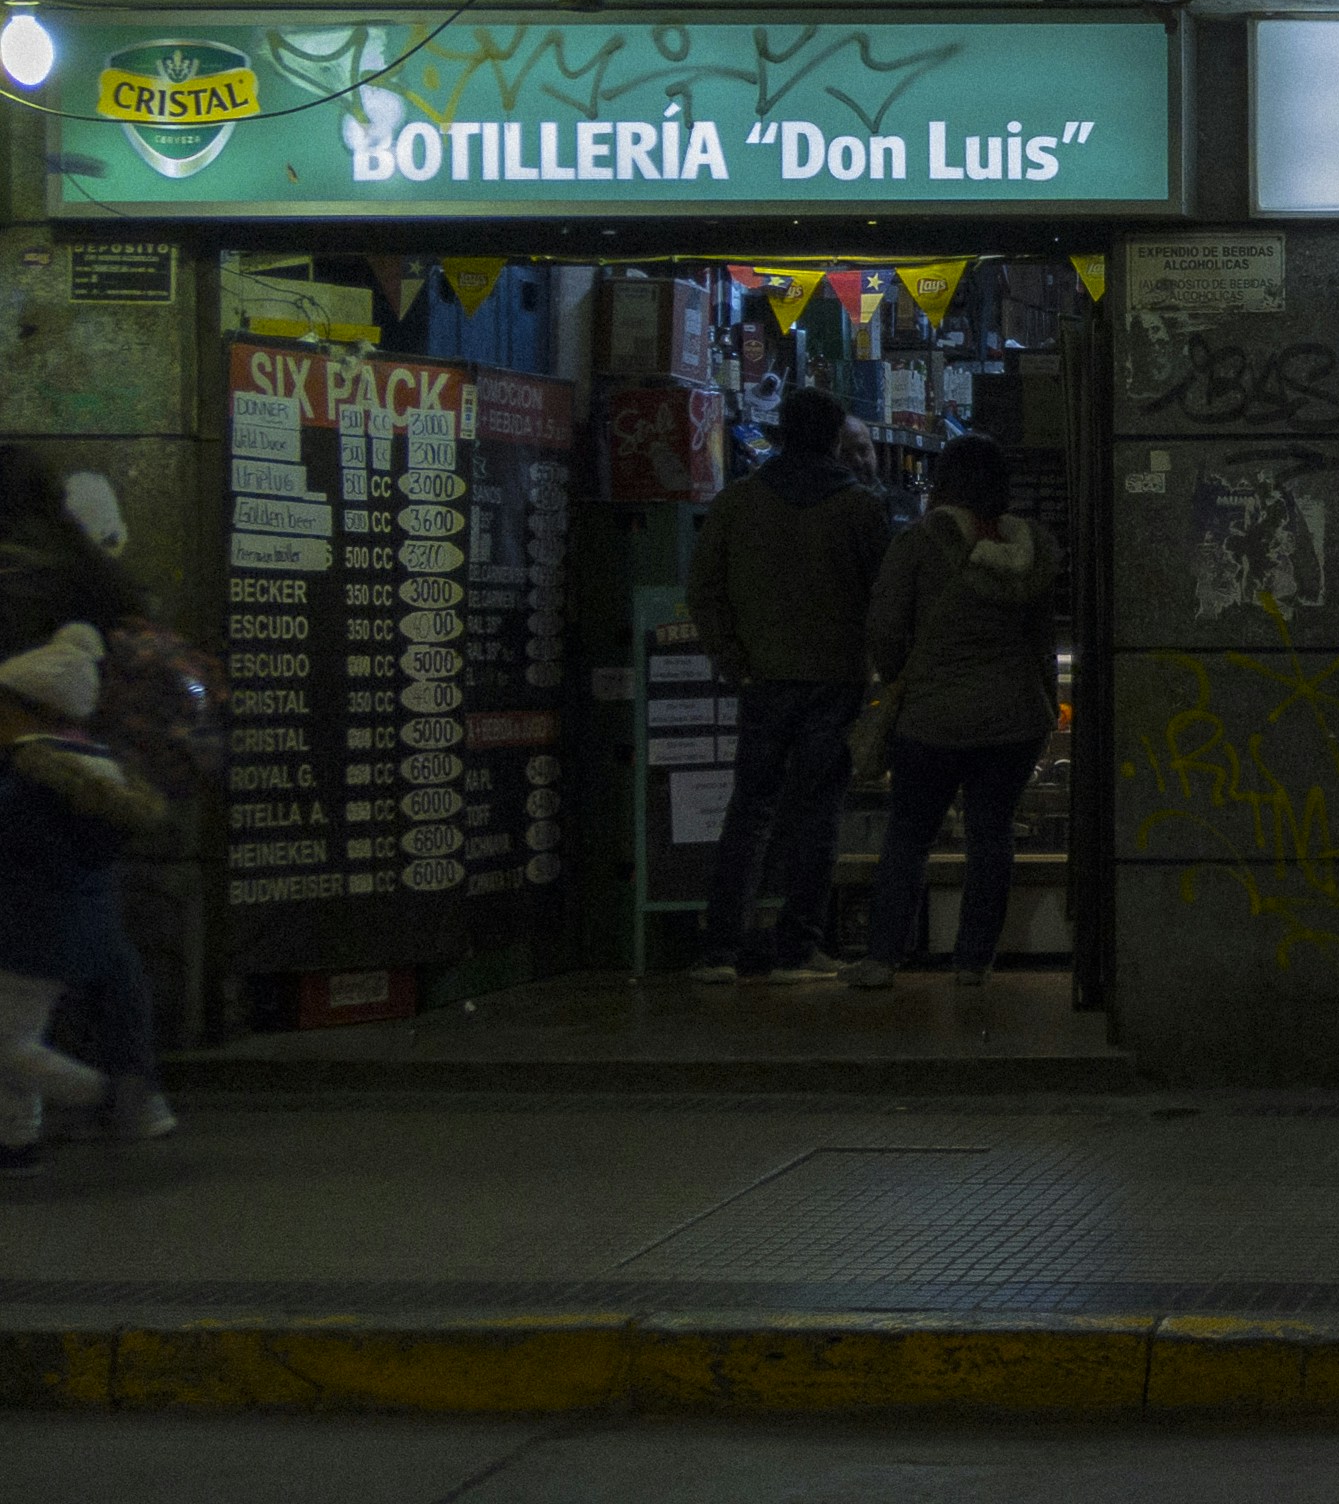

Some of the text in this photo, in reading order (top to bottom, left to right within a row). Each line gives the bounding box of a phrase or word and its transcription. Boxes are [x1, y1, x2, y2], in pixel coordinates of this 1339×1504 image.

[113, 81, 249, 118] CRISTAL
[352, 102, 729, 181] BOTILLERÍA
[1138, 246, 1274, 258] EXPENDIO DE BEBIDAS
[1163, 259, 1250, 270] ALCOHOLICAS
[1212, 279, 1227, 290] DE
[250, 351, 314, 419] SIX
[326, 361, 450, 428] PACK
[371, 476, 392, 497] CC
[409, 472, 454, 497] 3000
[371, 511, 392, 532] CC
[411, 508, 454, 532] 3600
[345, 546, 369, 569] 500
[373, 547, 393, 570] CC
[230, 578, 308, 604] BECKER
[346, 584, 369, 605] 350
[373, 584, 393, 606] CC
[410, 581, 452, 603] 3000
[229, 614, 309, 640] ESCUDO
[347, 619, 370, 640] 350
[373, 619, 394, 640] CC
[230, 653, 310, 678] ESCUDO
[375, 655, 395, 677] CC
[413, 650, 454, 673] 5000
[231, 691, 310, 716] CRISTAL
[348, 692, 371, 712] 350
[375, 692, 395, 713] CC
[231, 727, 310, 753] CRISTAL
[375, 727, 395, 748] CC
[413, 720, 454, 743] 5000
[230, 766, 294, 791] ROYAL
[374, 763, 395, 784] CC
[410, 756, 452, 779] 6600
[229, 801, 303, 829] STELLA
[374, 799, 395, 820] CC
[411, 791, 452, 814] 6000
[228, 839, 327, 868] HEINEKEN
[375, 836, 395, 857] CC
[413, 827, 454, 851] 6600
[229, 873, 345, 906] BUDWEISER
[376, 871, 396, 892] CC
[412, 861, 455, 886] 6000
